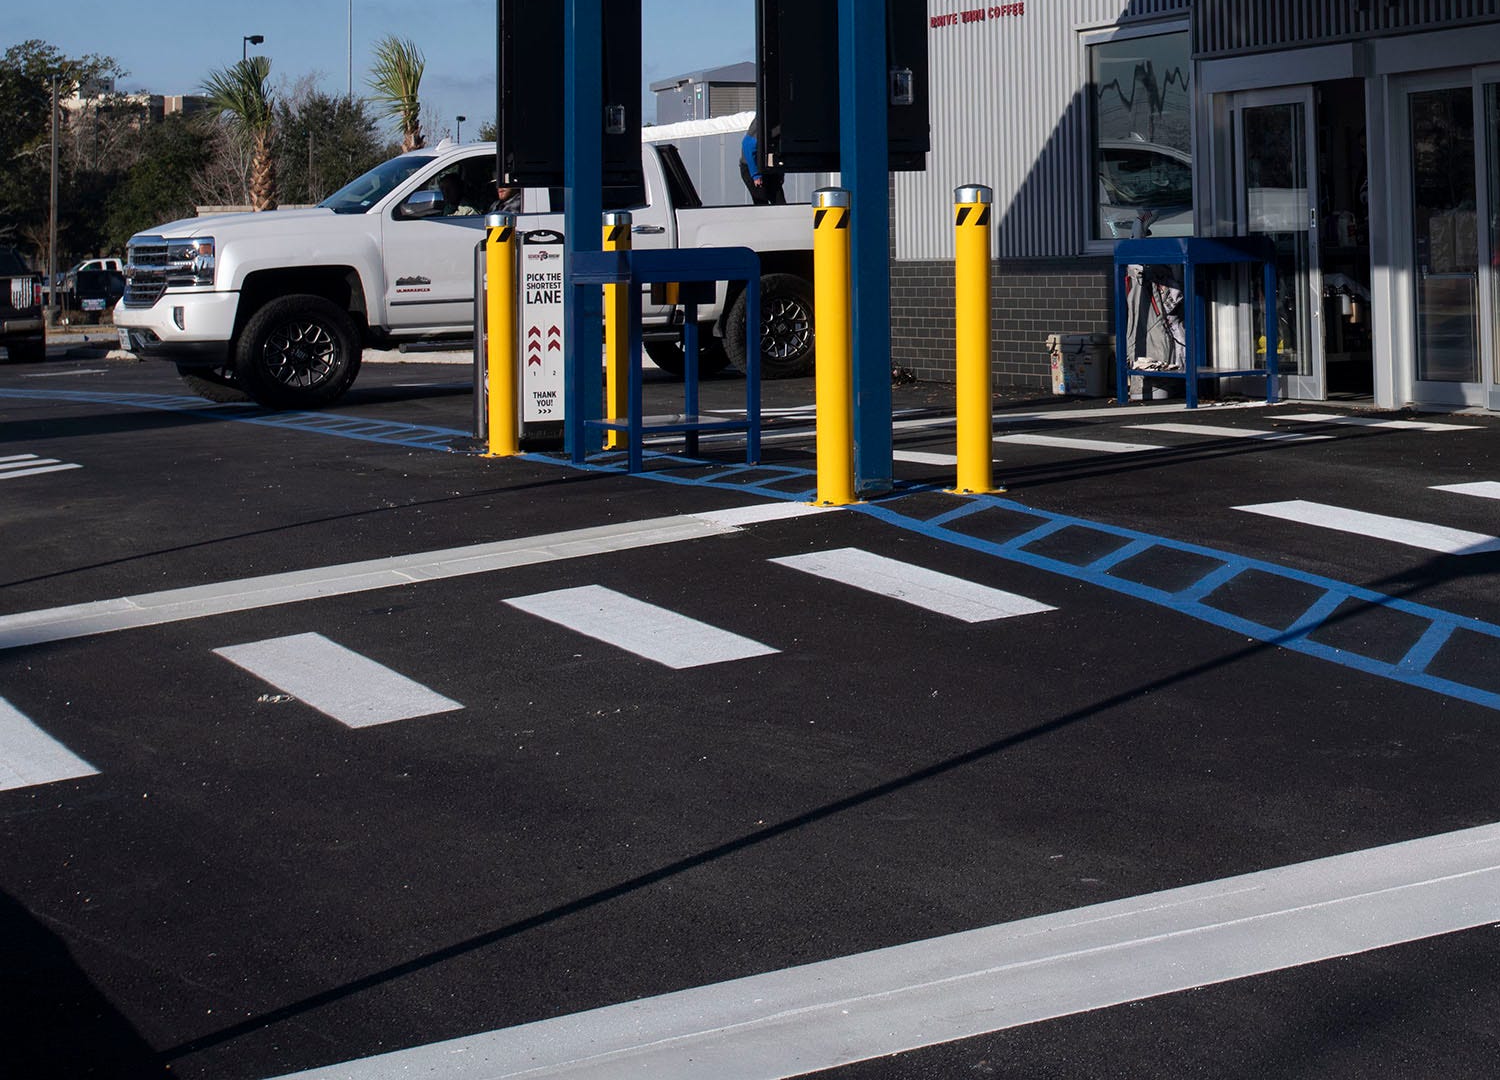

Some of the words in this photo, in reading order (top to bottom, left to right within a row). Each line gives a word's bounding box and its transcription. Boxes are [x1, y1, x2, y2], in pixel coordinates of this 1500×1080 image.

[930, 13, 958, 28] DRIVE
[960, 8, 985, 24] THRU
[988, 1, 1025, 19] COFFEE
[526, 273, 545, 281] PICK
[546, 272, 561, 281] THE
[526, 282, 561, 290] SHORTEST
[526, 290, 561, 304] LANE
[533, 391, 557, 399] THANK
[536, 399, 554, 407] YOU!
